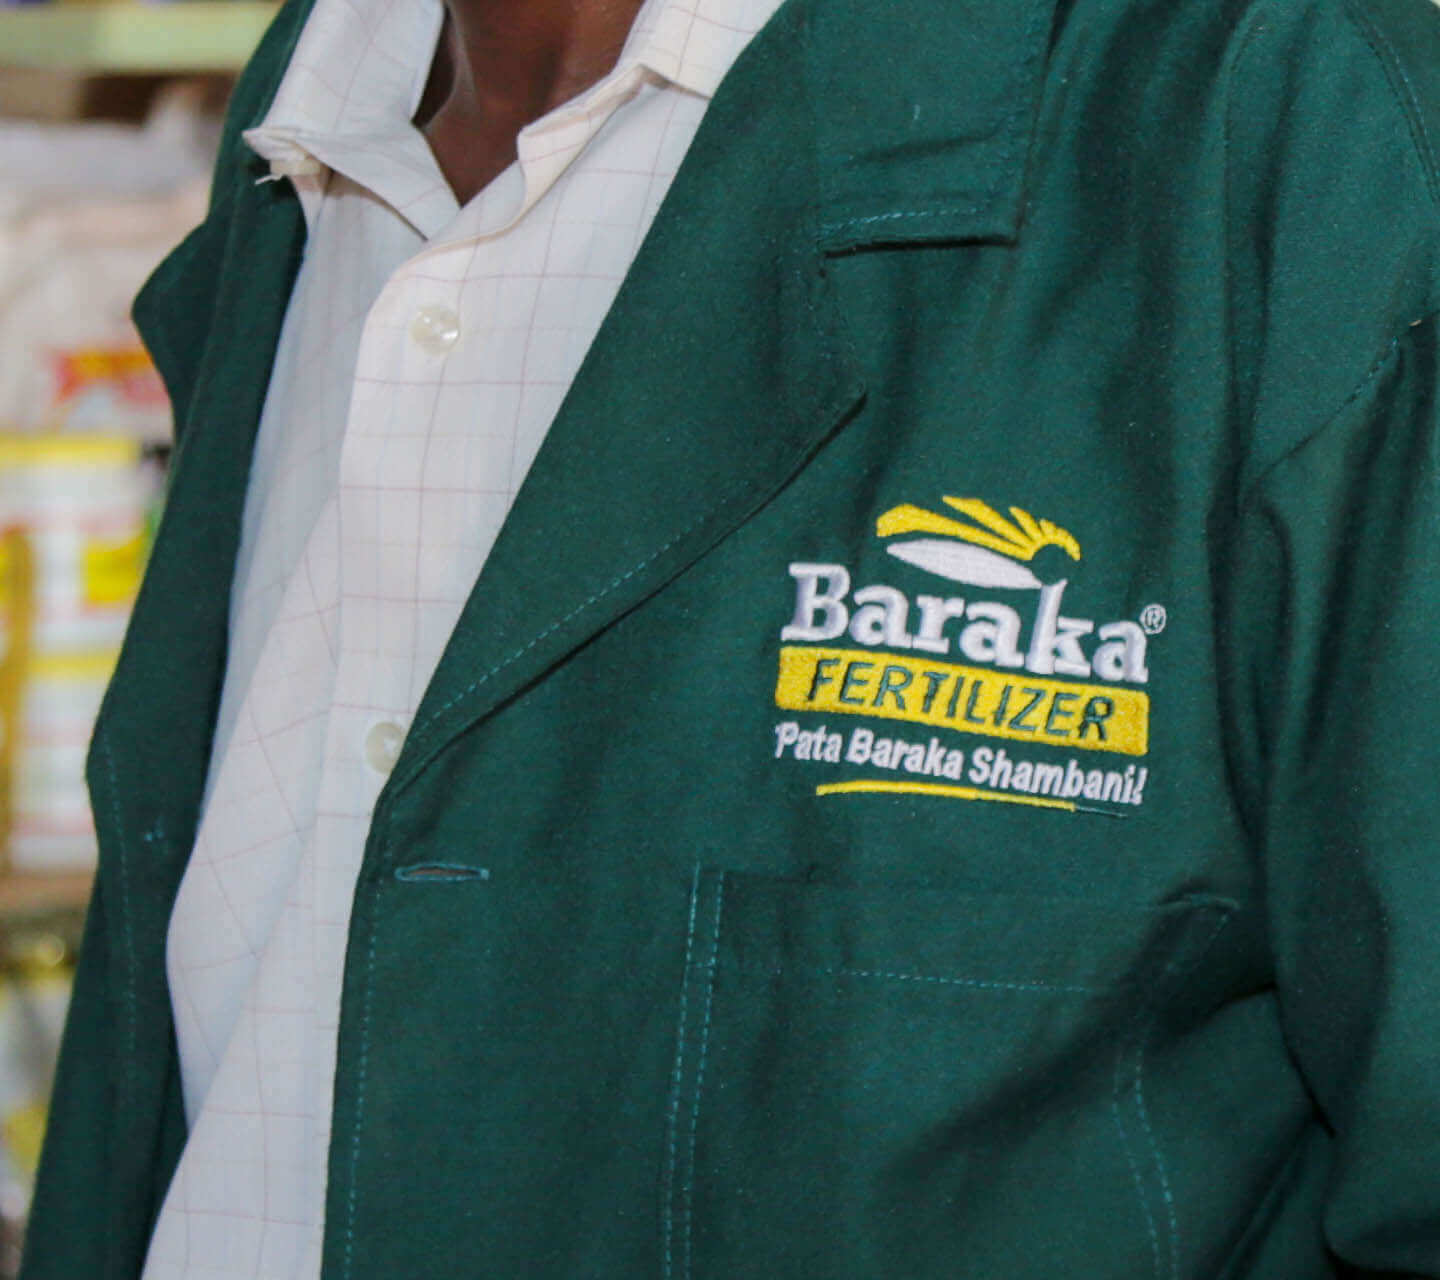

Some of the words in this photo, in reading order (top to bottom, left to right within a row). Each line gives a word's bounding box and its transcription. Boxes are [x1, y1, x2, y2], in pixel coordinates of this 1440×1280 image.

[780, 561, 1149, 684] Baraka
[806, 656, 1114, 742] FERTILIZER
[773, 721, 842, 763] Pata
[846, 728, 965, 781] Baraka
[968, 746, 1148, 806] Shambani!
